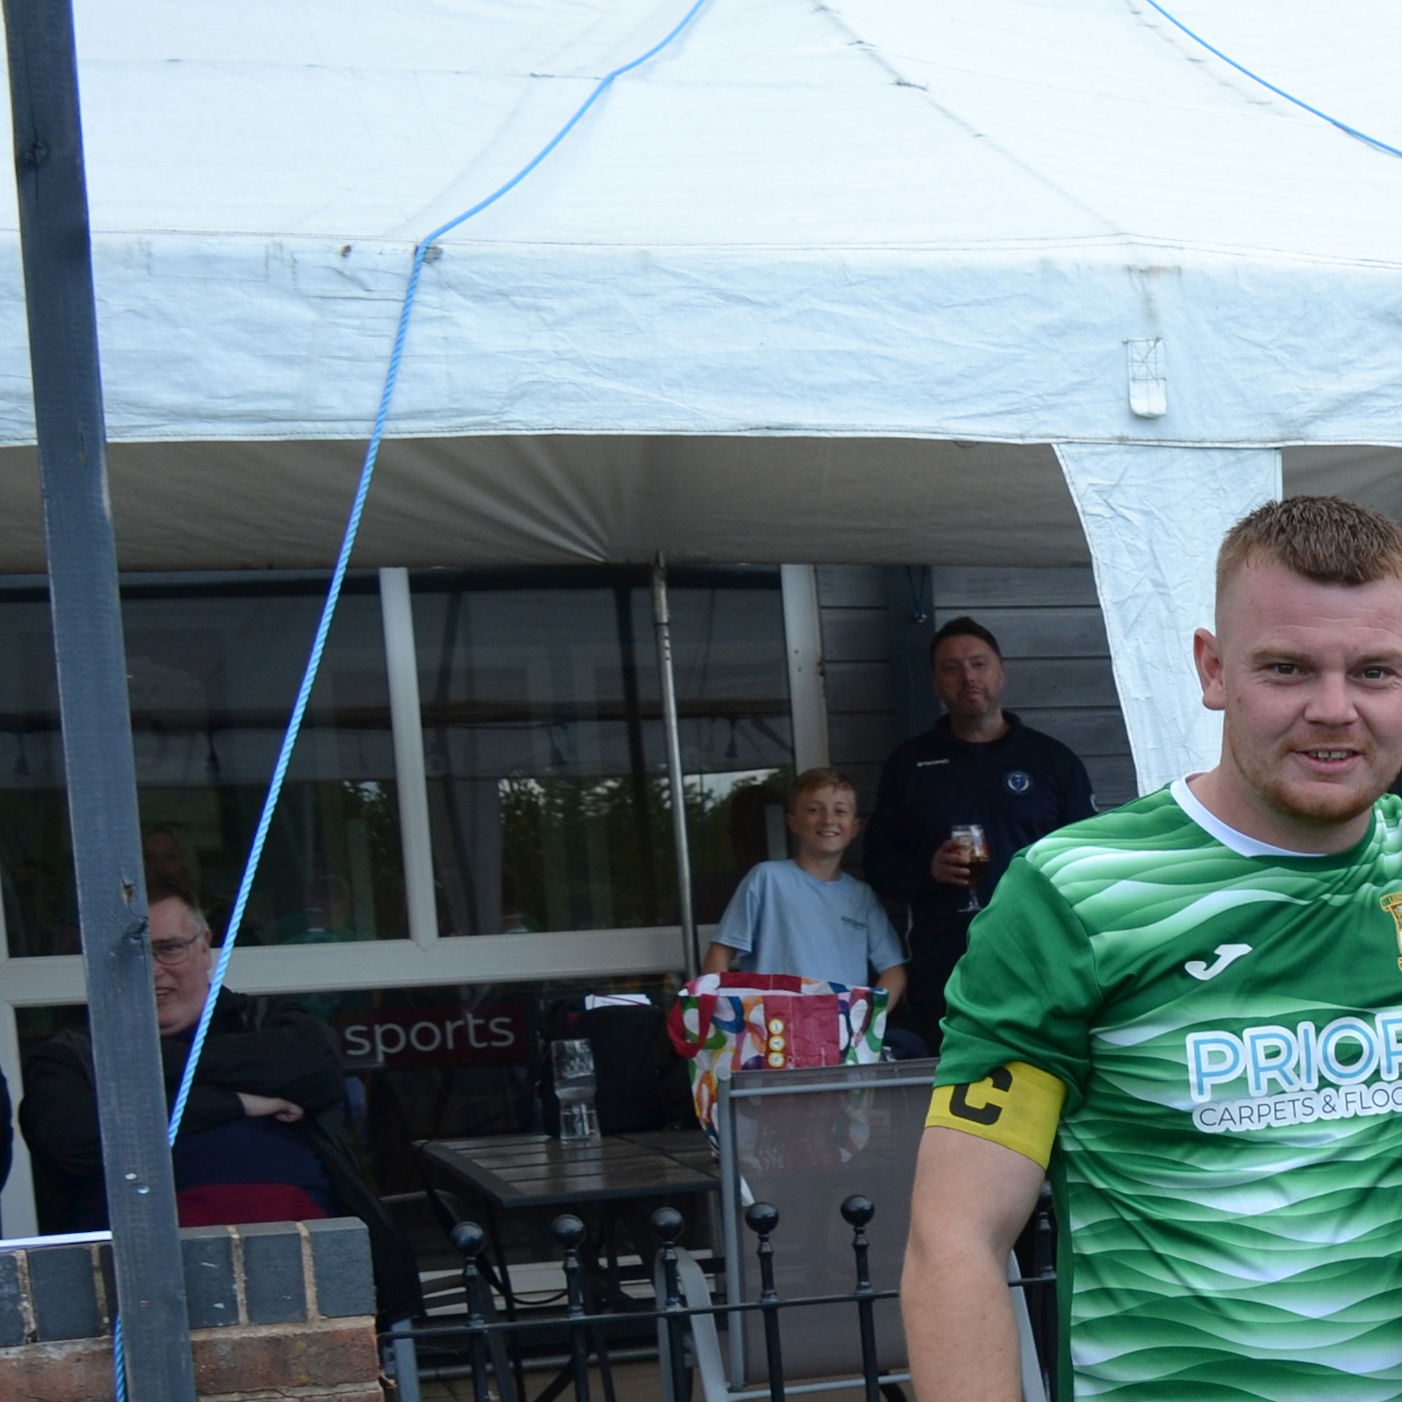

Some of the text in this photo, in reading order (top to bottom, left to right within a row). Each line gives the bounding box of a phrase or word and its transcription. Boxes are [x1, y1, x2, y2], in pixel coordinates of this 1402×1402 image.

[344, 1013, 515, 1063] sports
[949, 1066, 1013, 1126] C
[1199, 1096, 1316, 1127] CARPETS
[1322, 1094, 1338, 1115] &
